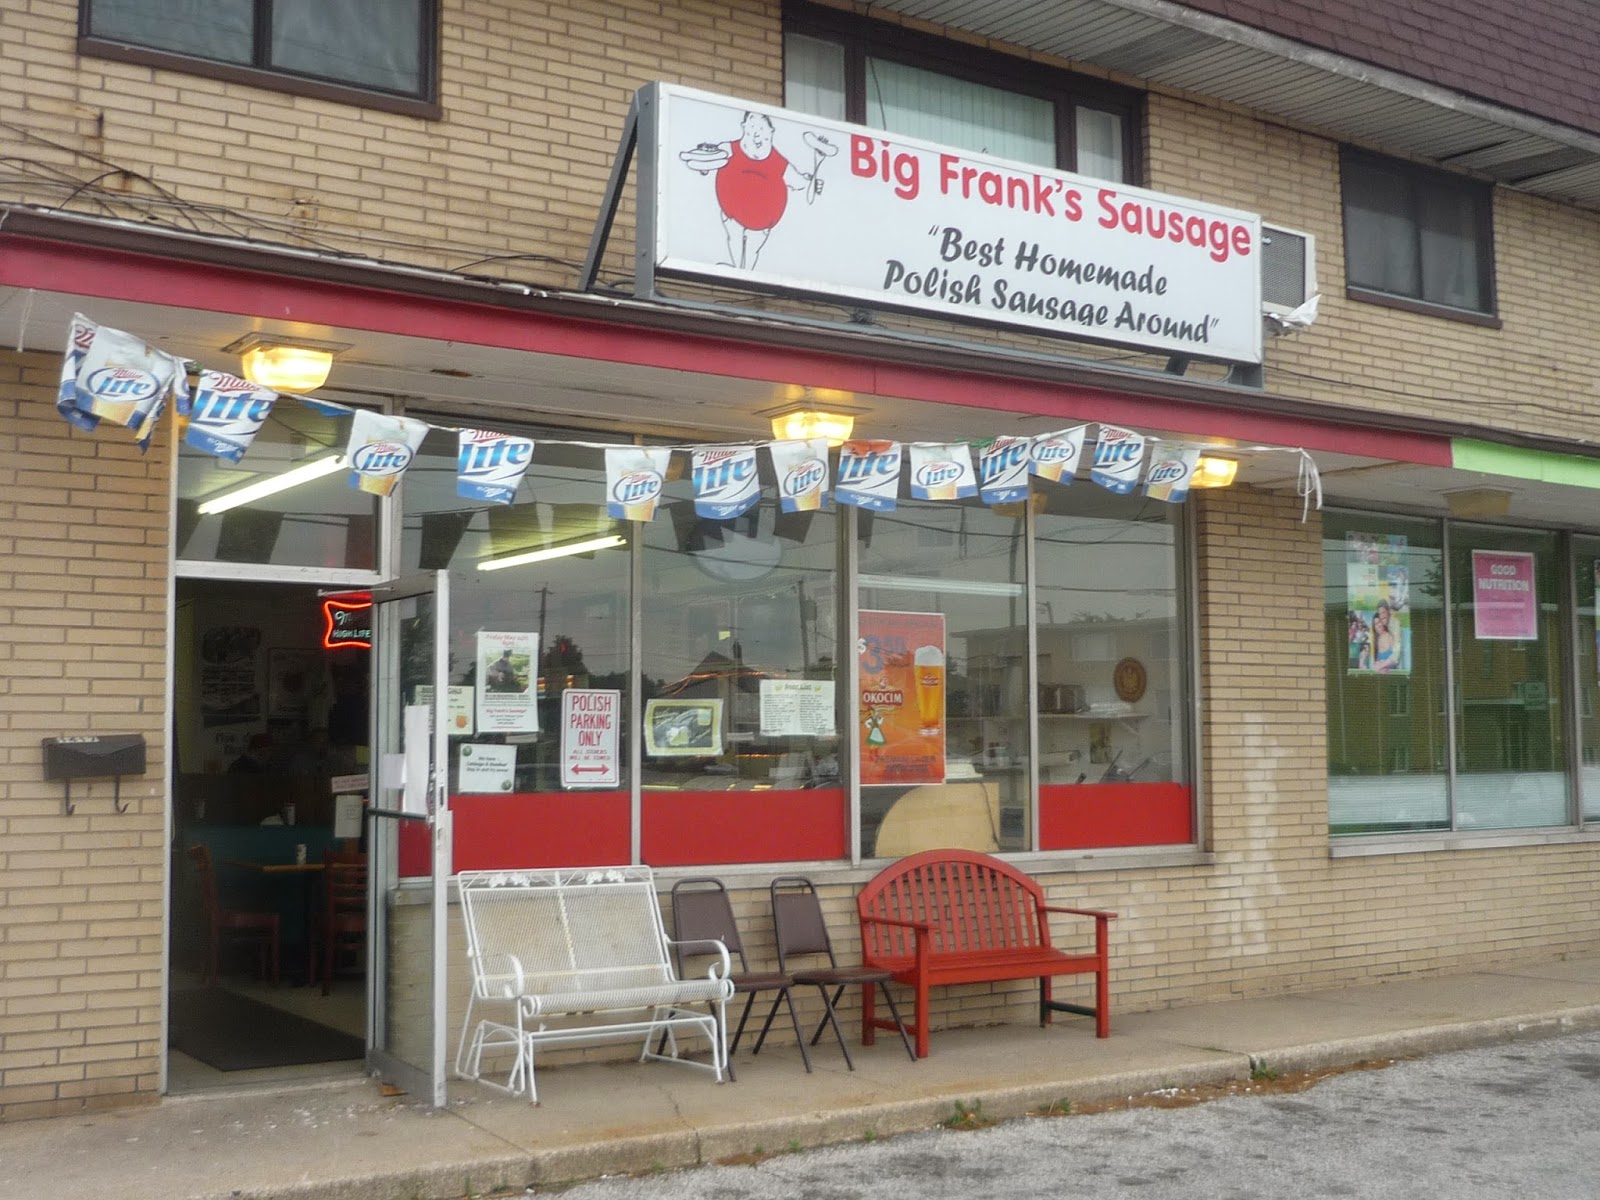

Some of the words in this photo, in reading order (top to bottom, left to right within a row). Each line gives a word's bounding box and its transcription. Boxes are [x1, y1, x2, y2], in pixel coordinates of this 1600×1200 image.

[851, 134, 919, 200] Big
[940, 153, 1082, 222] Frank's
[1097, 188, 1250, 263] Sausage
[1015, 241, 1167, 295] Homemade
[883, 259, 981, 304] Polish
[991, 279, 1108, 326] Sausage
[112, 368, 143, 380] Miller
[209, 374, 262, 393] Miller
[99, 377, 151, 397] Lite
[191, 389, 273, 426] Lite
[1105, 428, 1134, 441] Miller
[375, 443, 400, 452] Miller
[1036, 446, 1069, 461] Lite
[1092, 439, 1141, 470] Lite
[361, 450, 406, 471] Lite
[459, 440, 530, 476] Lite
[702, 450, 738, 465] Miller
[981, 443, 1027, 486] Lite
[694, 457, 754, 498] Lite
[838, 451, 898, 485] Lite
[924, 467, 958, 486] Lite
[1150, 467, 1182, 484] Lite
[629, 474, 652, 483] Miller
[792, 466, 821, 497] Lite
[622, 480, 658, 502] Lite
[1490, 564, 1516, 575] GOOD
[1477, 578, 1529, 591] NUTRITION
[332, 629, 353, 638] HIGH
[353, 629, 372, 638] LIFE
[572, 695, 612, 711] POLISH
[862, 691, 902, 704] OKOCIM
[570, 713, 611, 729] PARKING
[578, 730, 602, 747] ONLY
